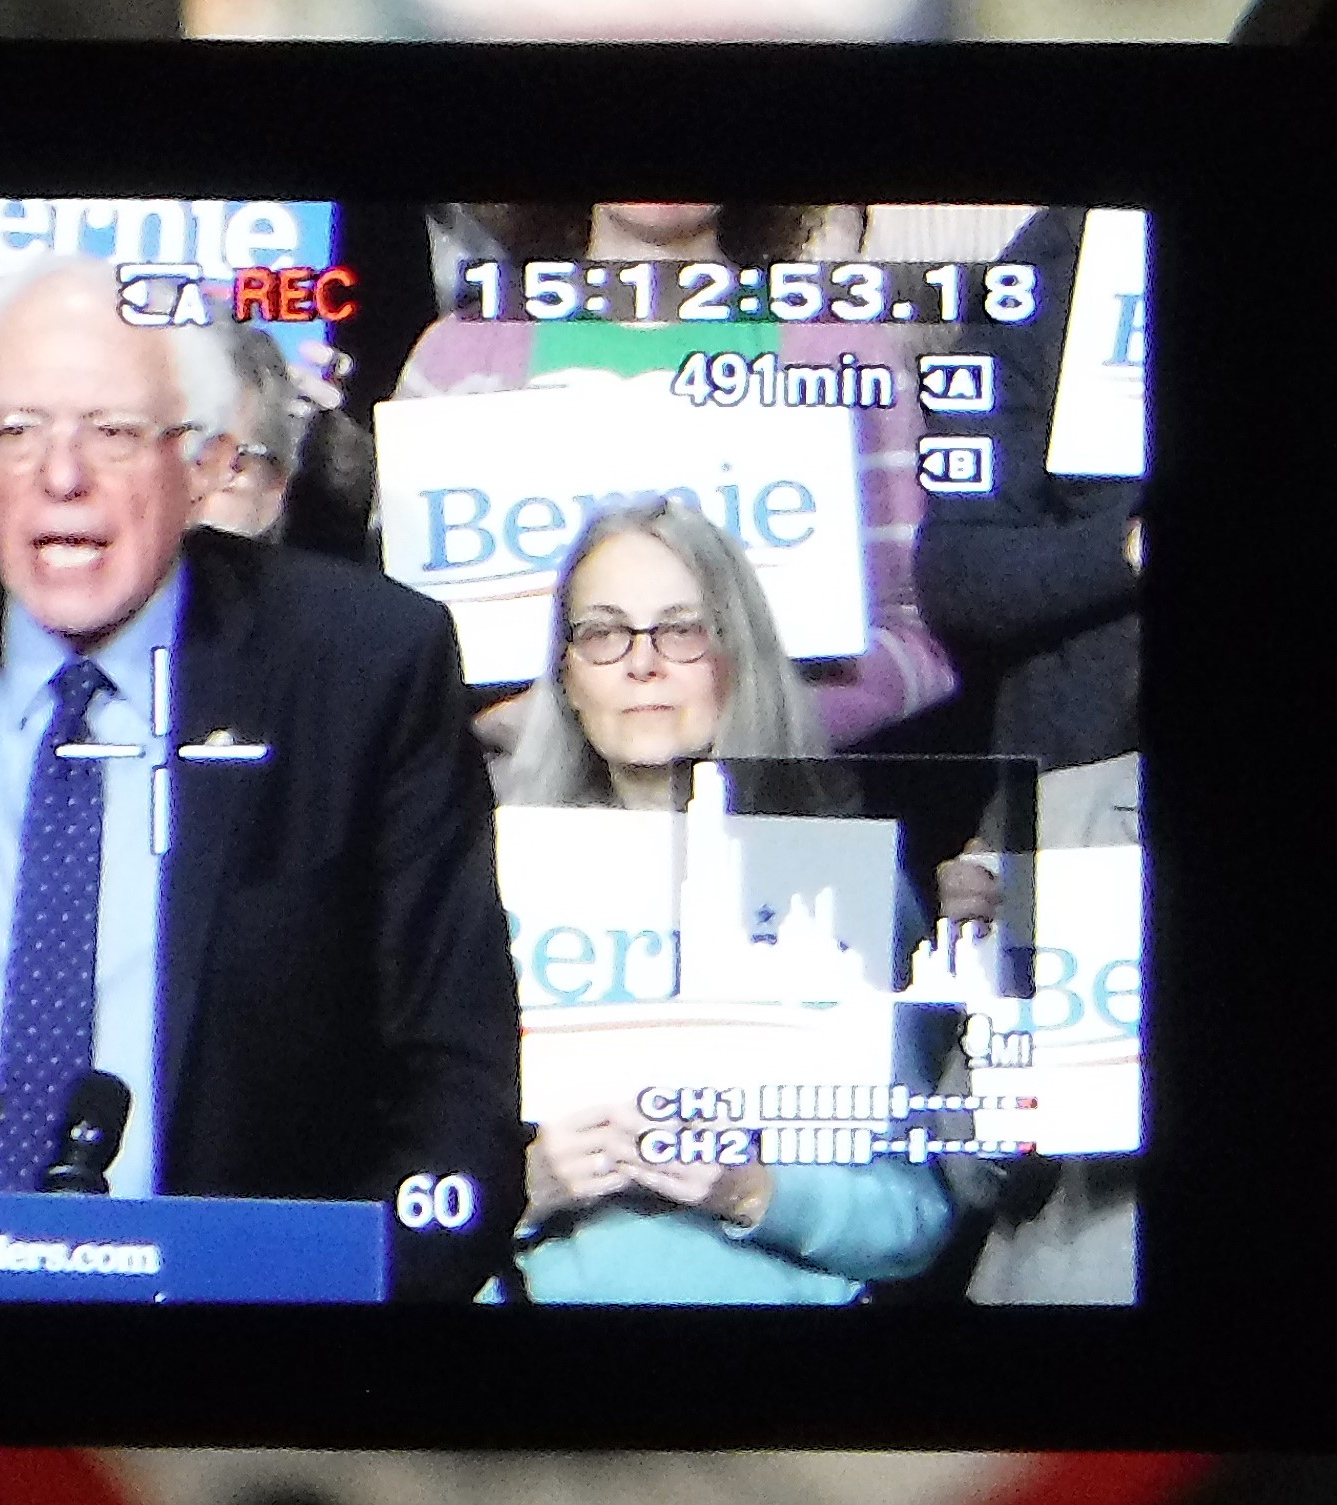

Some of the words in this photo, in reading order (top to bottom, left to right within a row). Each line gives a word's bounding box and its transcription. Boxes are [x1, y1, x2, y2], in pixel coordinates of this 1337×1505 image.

[235, 266, 355, 323] REC
[465, 262, 1038, 321] 15:12:53.18
[671, 353, 893, 407] 491min
[419, 462, 817, 572] Beie
[637, 1086, 745, 1121] CH1
[637, 1128, 751, 1166] CH2
[396, 1173, 474, 1229] 60
